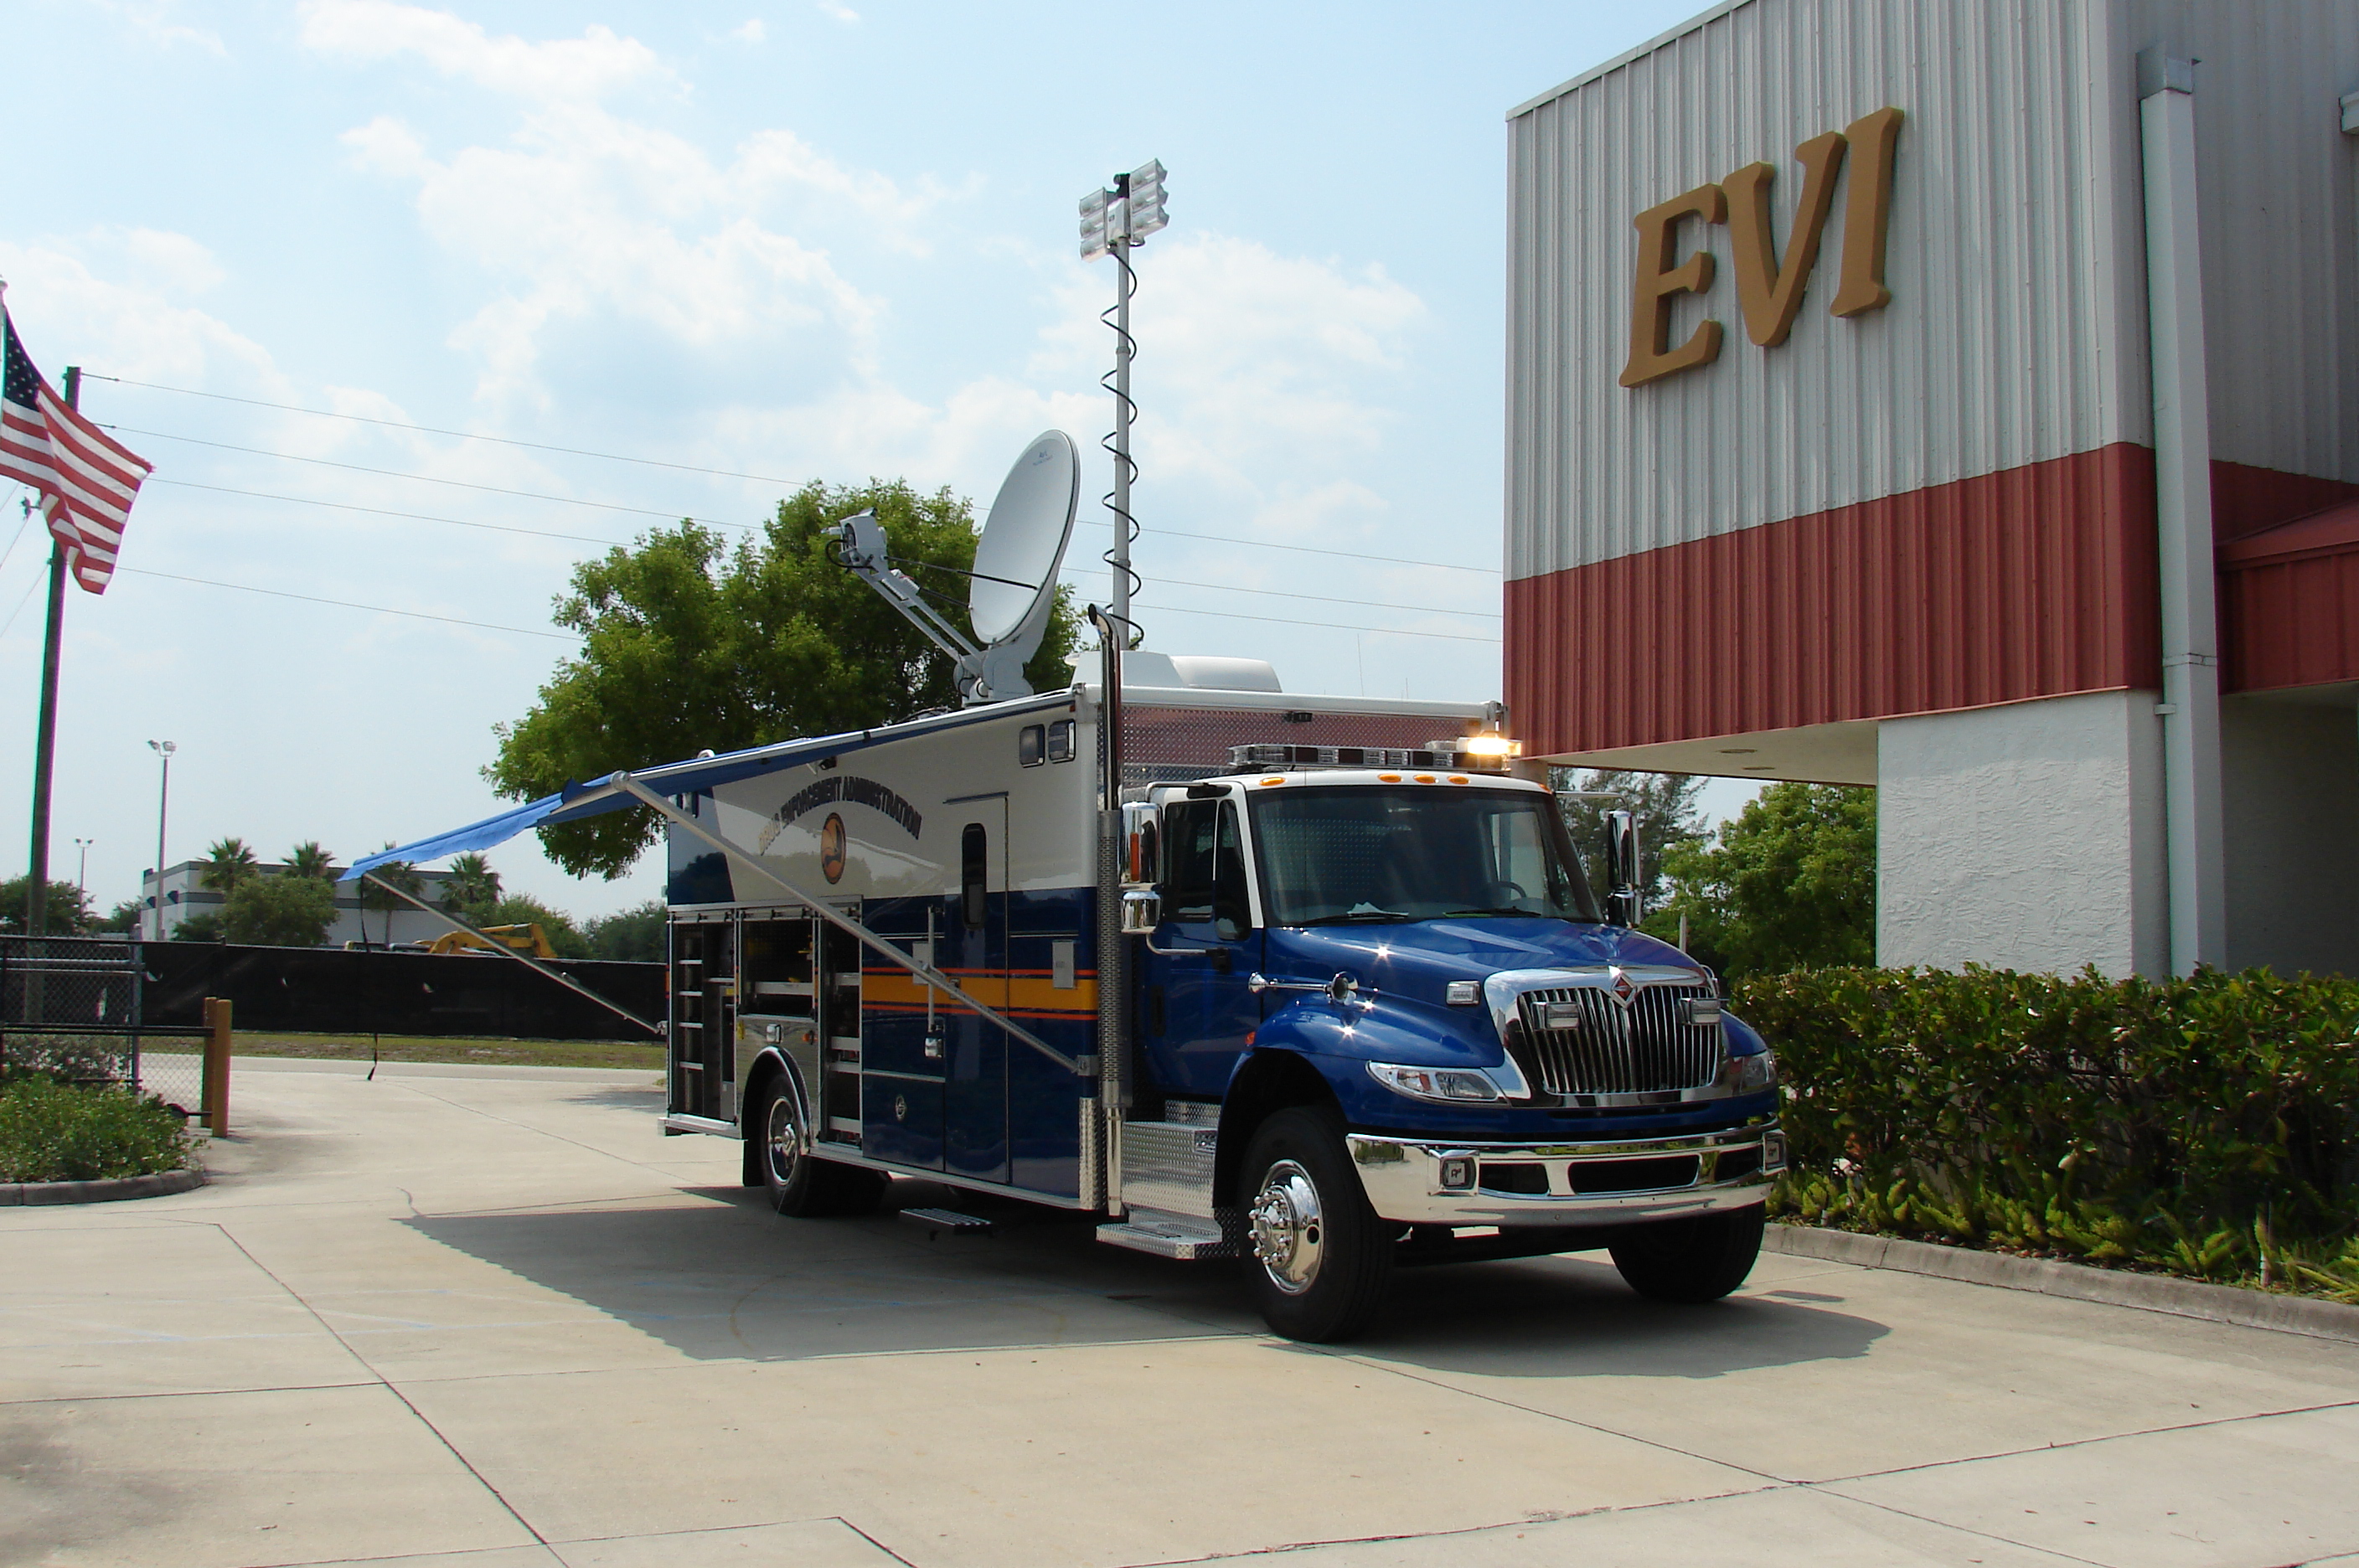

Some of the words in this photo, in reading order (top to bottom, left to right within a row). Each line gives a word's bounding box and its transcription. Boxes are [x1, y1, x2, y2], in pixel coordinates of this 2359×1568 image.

[1618, 106, 1905, 388] EVI
[781, 776, 842, 829] ENFORCEMENT
[842, 776, 922, 840] ADMINISTRATION
